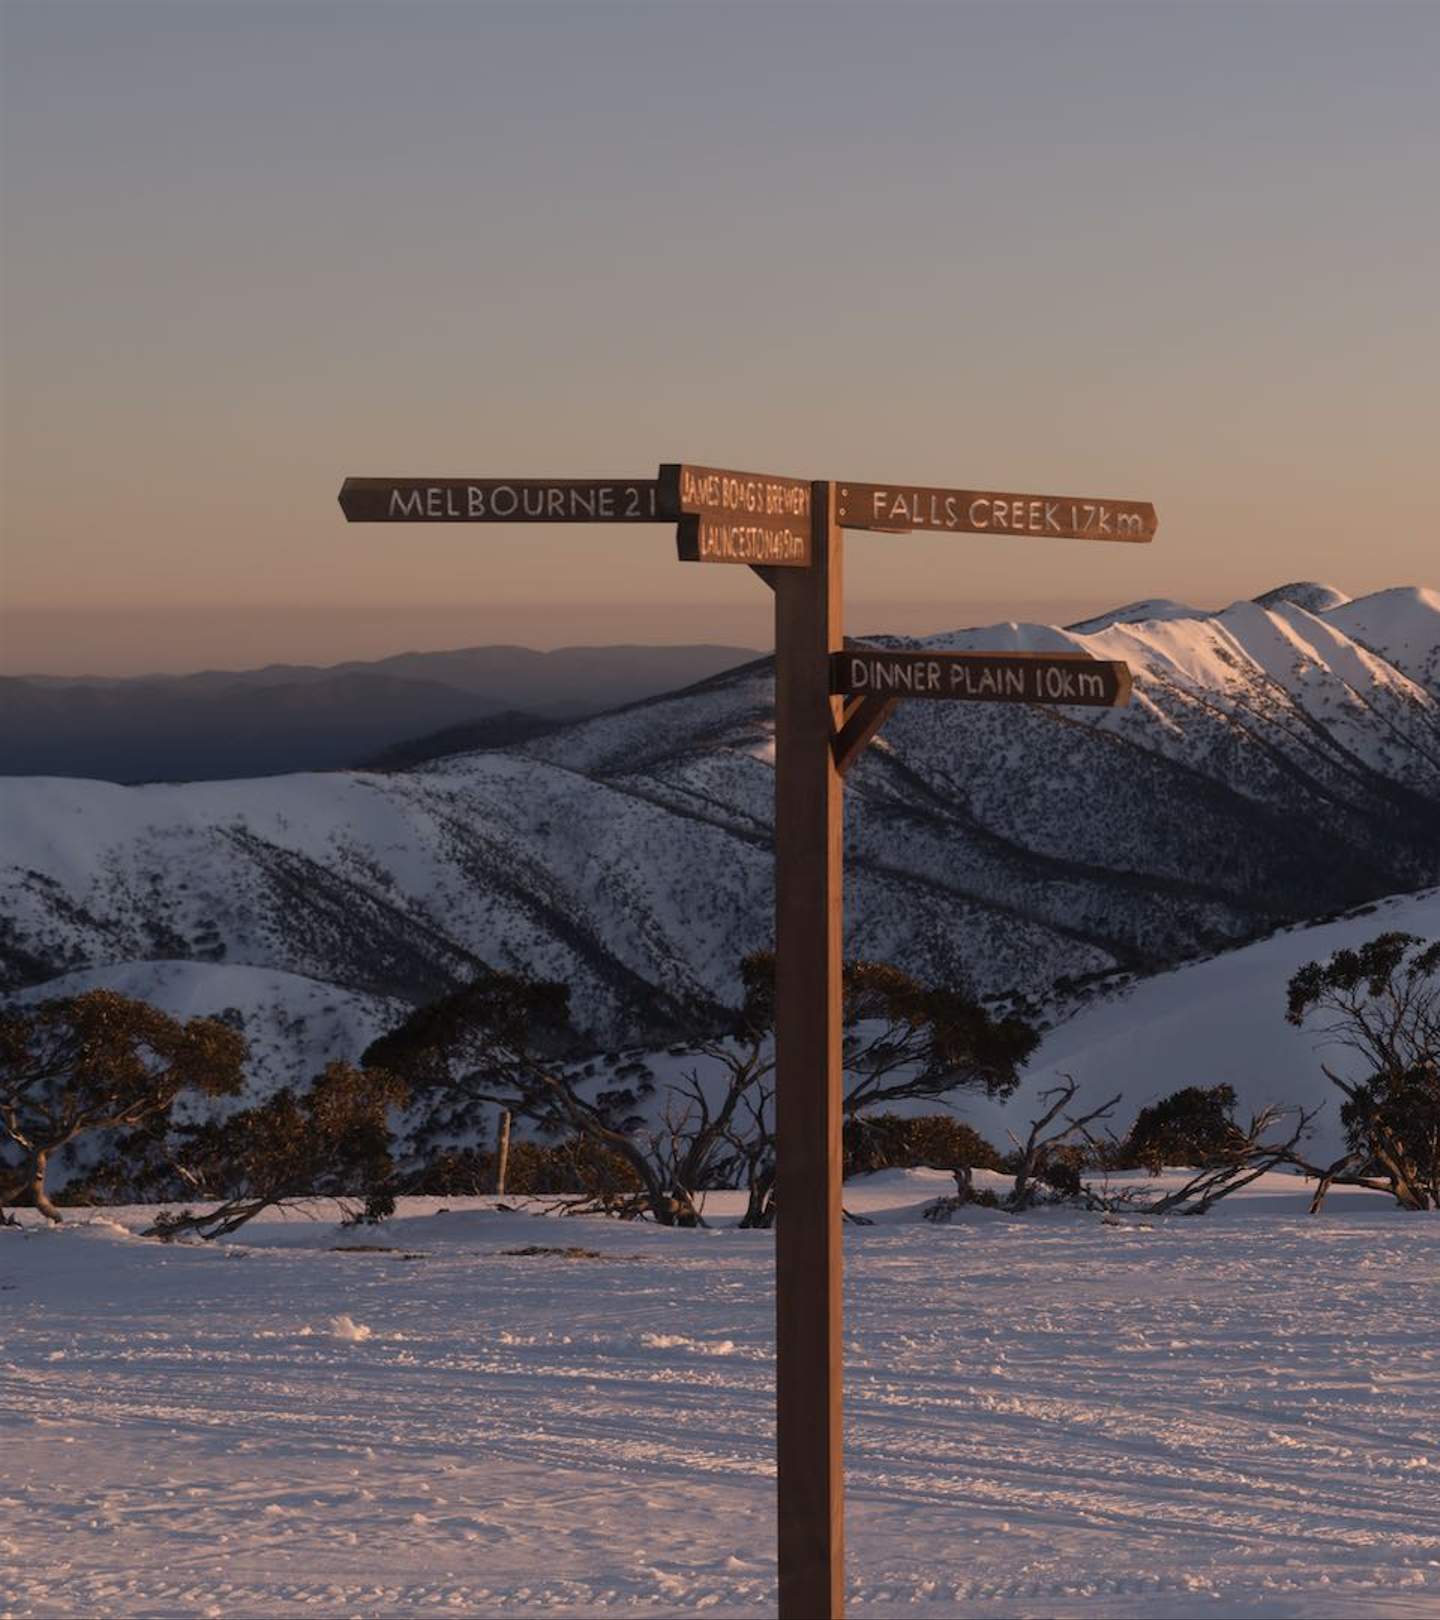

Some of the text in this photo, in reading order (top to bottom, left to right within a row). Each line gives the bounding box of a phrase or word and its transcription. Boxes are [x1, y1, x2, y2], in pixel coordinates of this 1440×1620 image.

[388, 486, 614, 517] MELBOURNE
[682, 471, 720, 506] JAMES
[766, 483, 811, 516] BREWERY
[872, 491, 1143, 534] FALLS CREEK 17km
[851, 658, 1104, 698] DINNER PLAIN 10km
